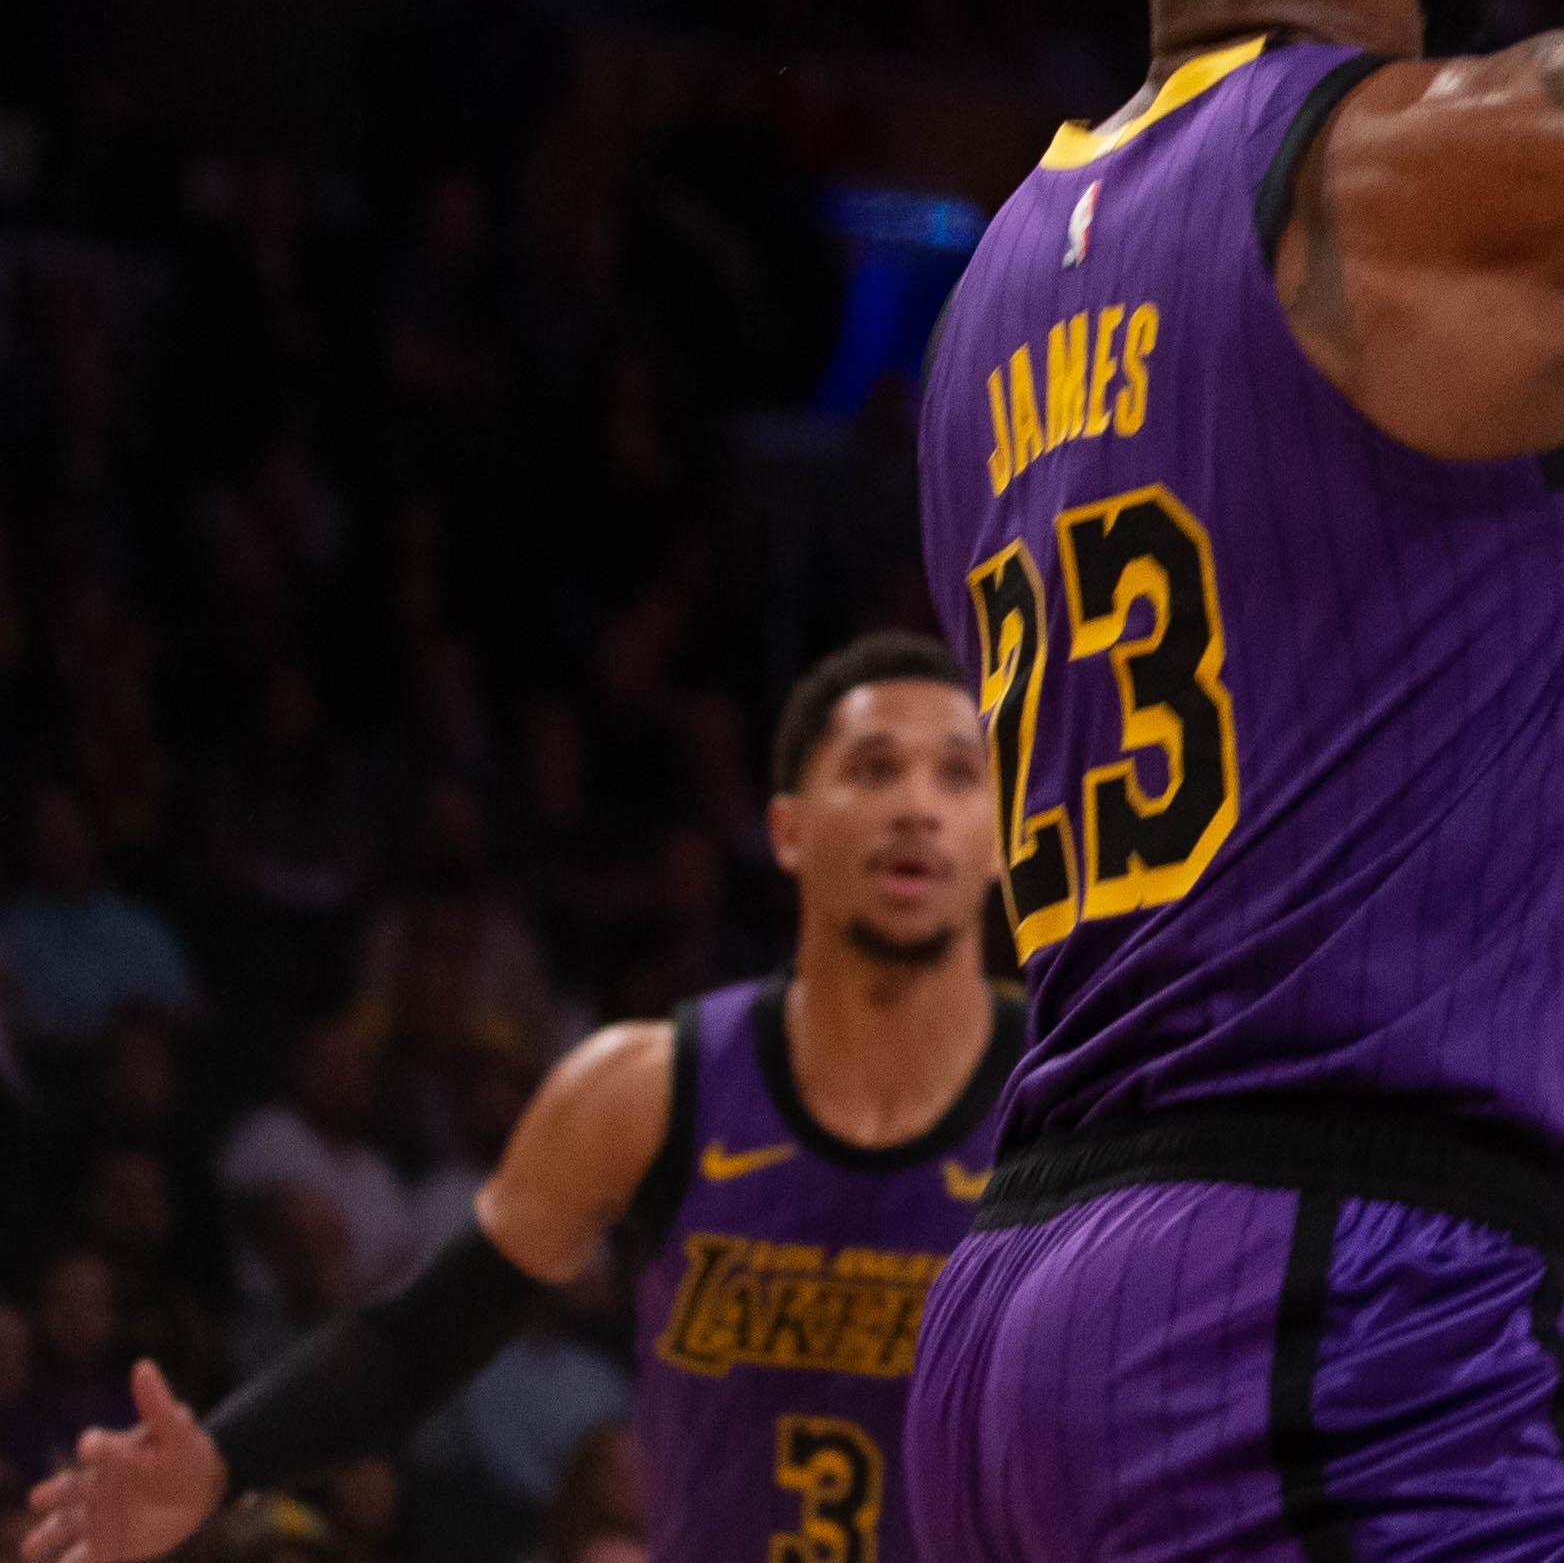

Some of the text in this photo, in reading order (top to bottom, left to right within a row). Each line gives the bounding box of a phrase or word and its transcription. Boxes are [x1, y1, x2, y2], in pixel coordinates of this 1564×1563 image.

[986, 303, 1160, 498] JAMES
[966, 482, 1240, 966] 23
[768, 1412, 885, 1563] 3
